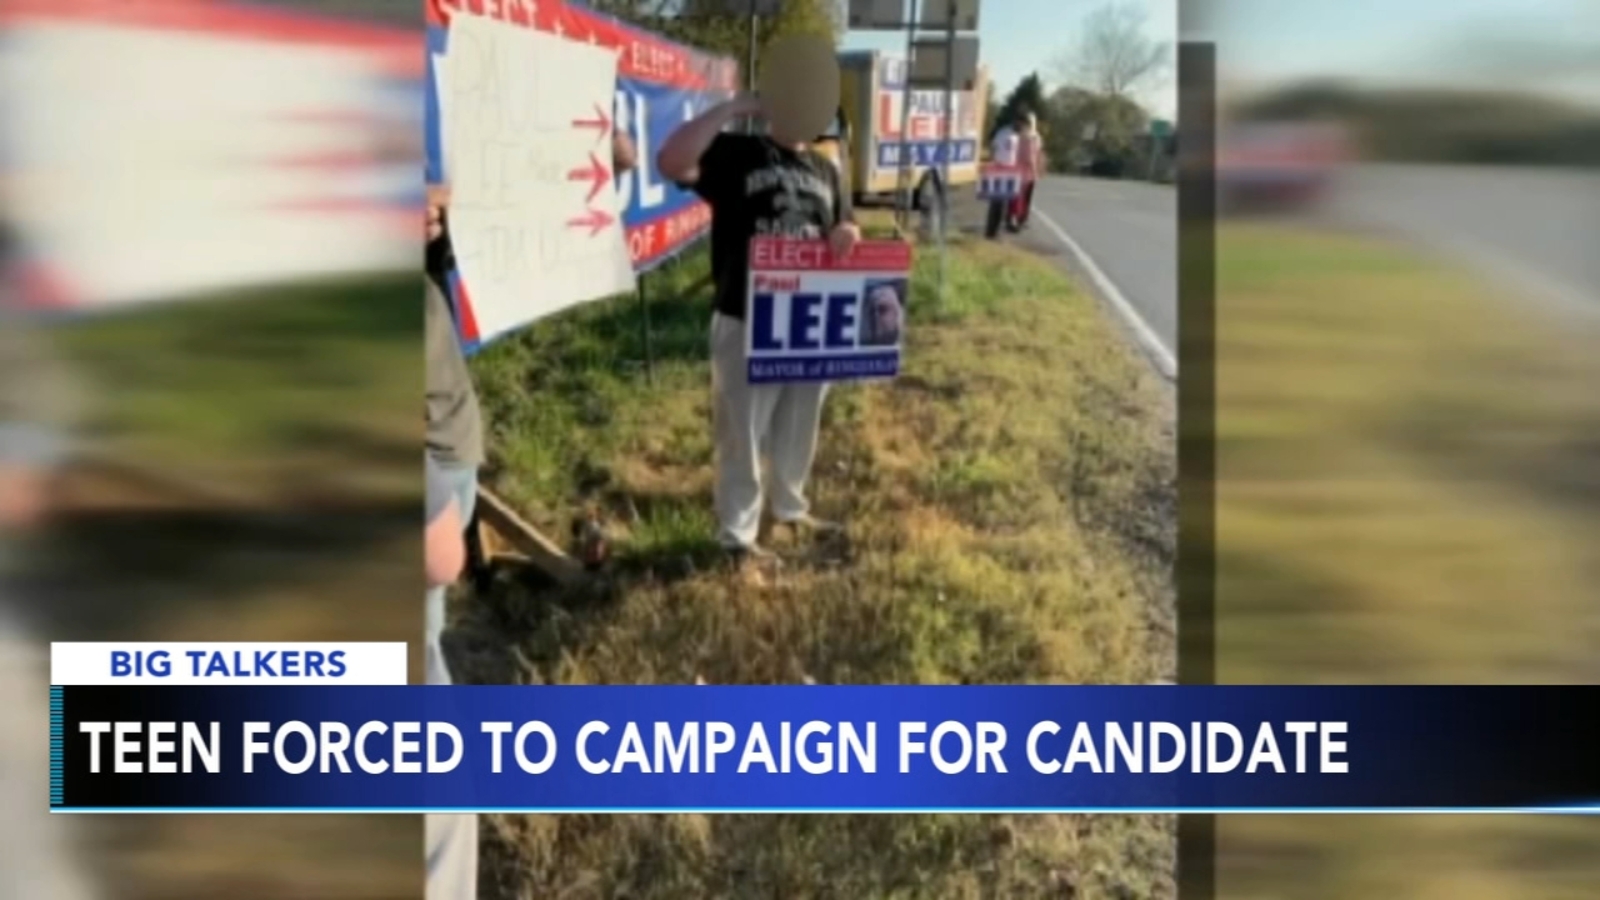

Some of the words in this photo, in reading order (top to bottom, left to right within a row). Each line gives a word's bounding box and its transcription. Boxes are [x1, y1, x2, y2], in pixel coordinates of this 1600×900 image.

[628, 223, 655, 261] OF
[754, 242, 827, 267] ELECT
[754, 275, 801, 291] Paul
[752, 293, 857, 350] LEE
[751, 361, 803, 377] MAYOR
